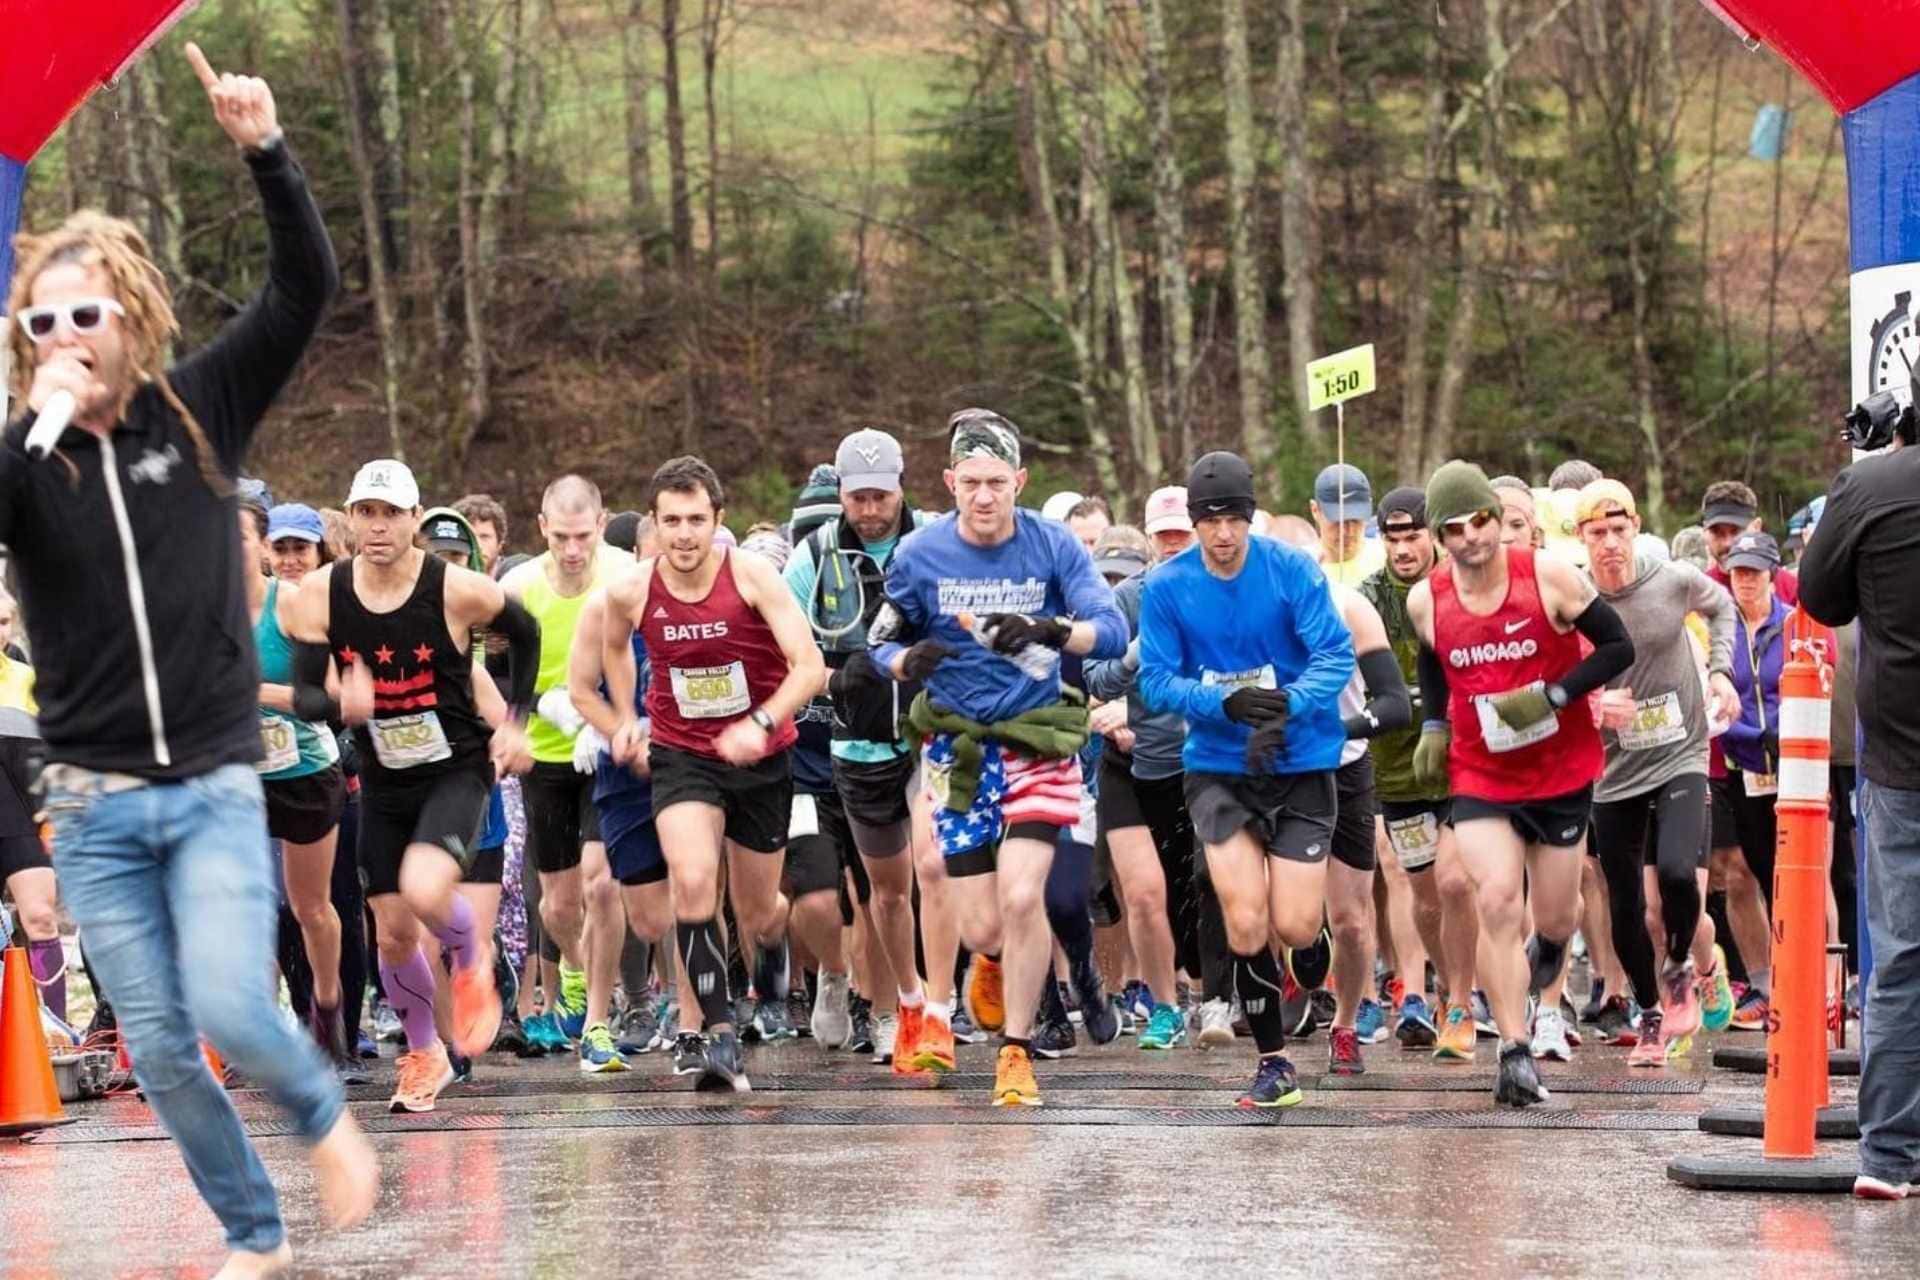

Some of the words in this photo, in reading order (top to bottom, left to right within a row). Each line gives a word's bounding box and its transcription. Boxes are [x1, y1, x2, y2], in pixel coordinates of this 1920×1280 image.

[1324, 370, 1359, 398] 1:50
[663, 621, 729, 641] BATES
[1449, 638, 1537, 668] CHICAGO
